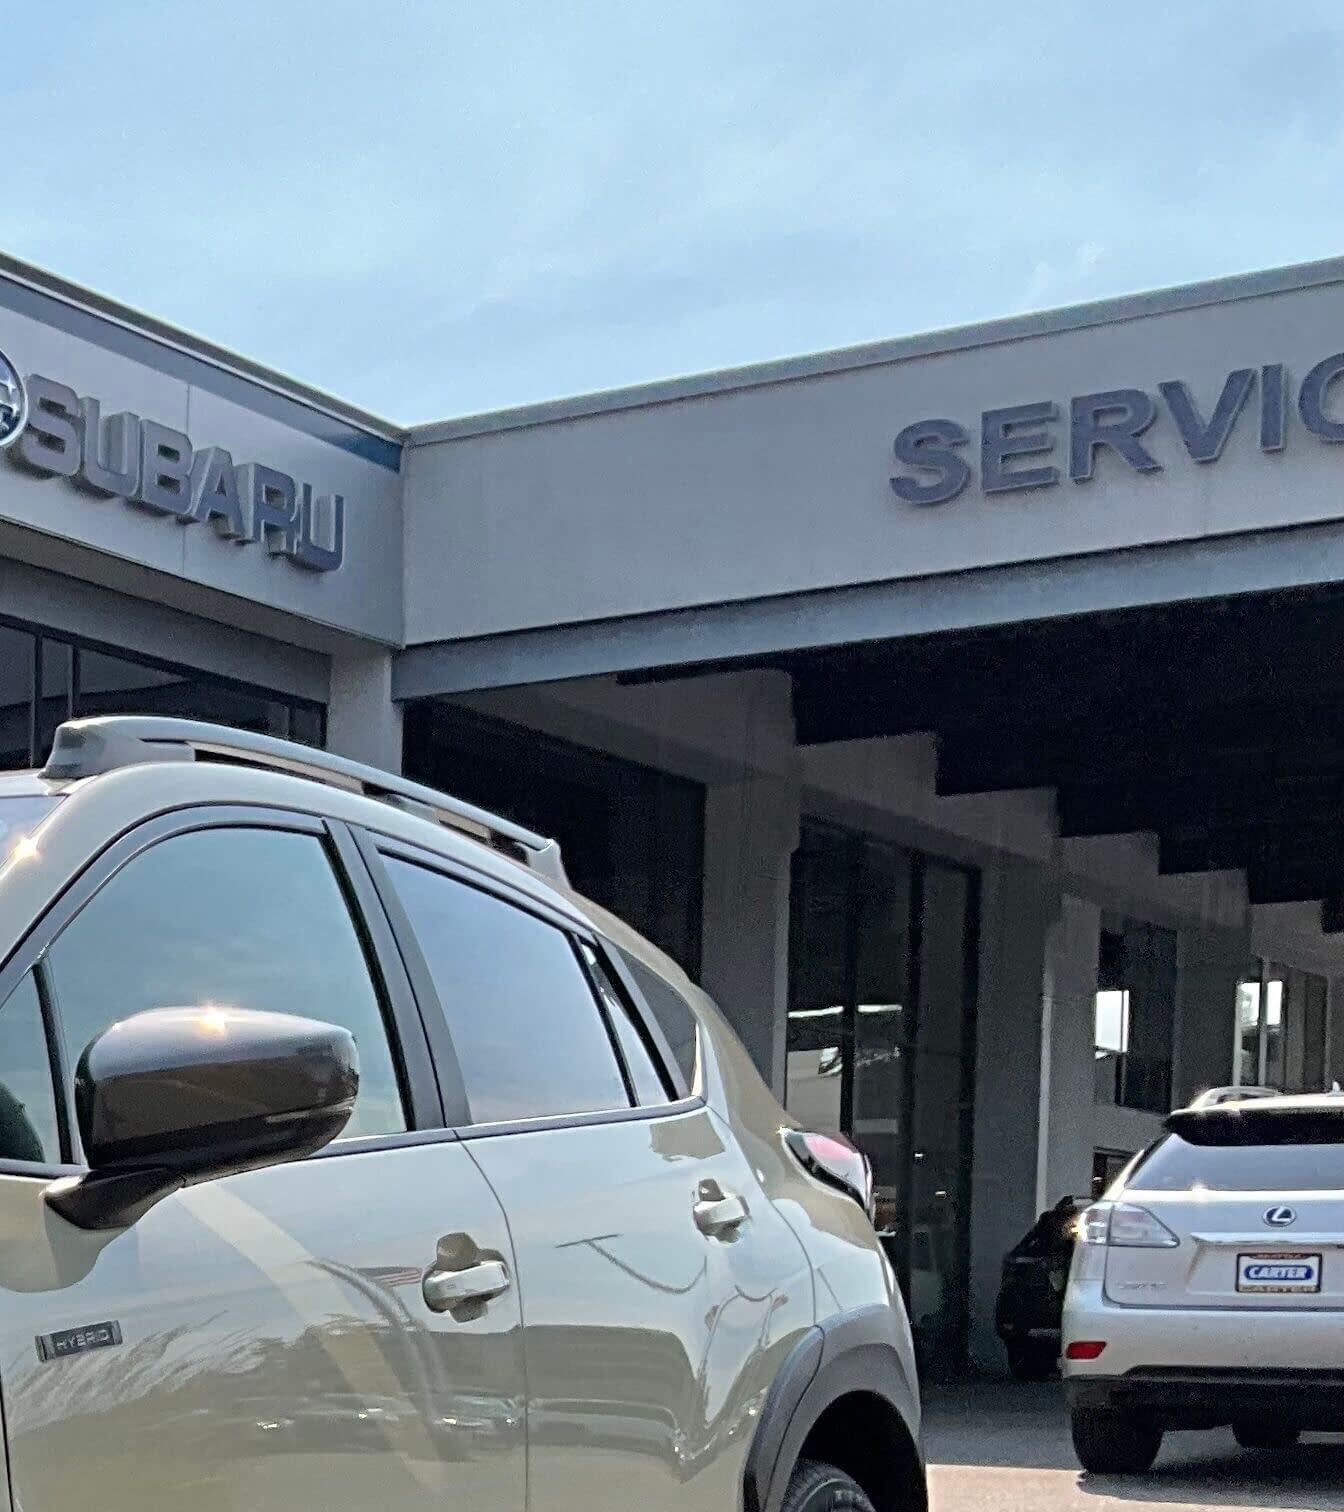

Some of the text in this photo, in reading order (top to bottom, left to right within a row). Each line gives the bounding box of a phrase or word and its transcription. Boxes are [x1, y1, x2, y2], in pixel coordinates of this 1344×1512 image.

[18, 373, 345, 573] SUBARU
[1248, 1265, 1309, 1279] CARTER
[55, 1328, 111, 1350] HYBRD
